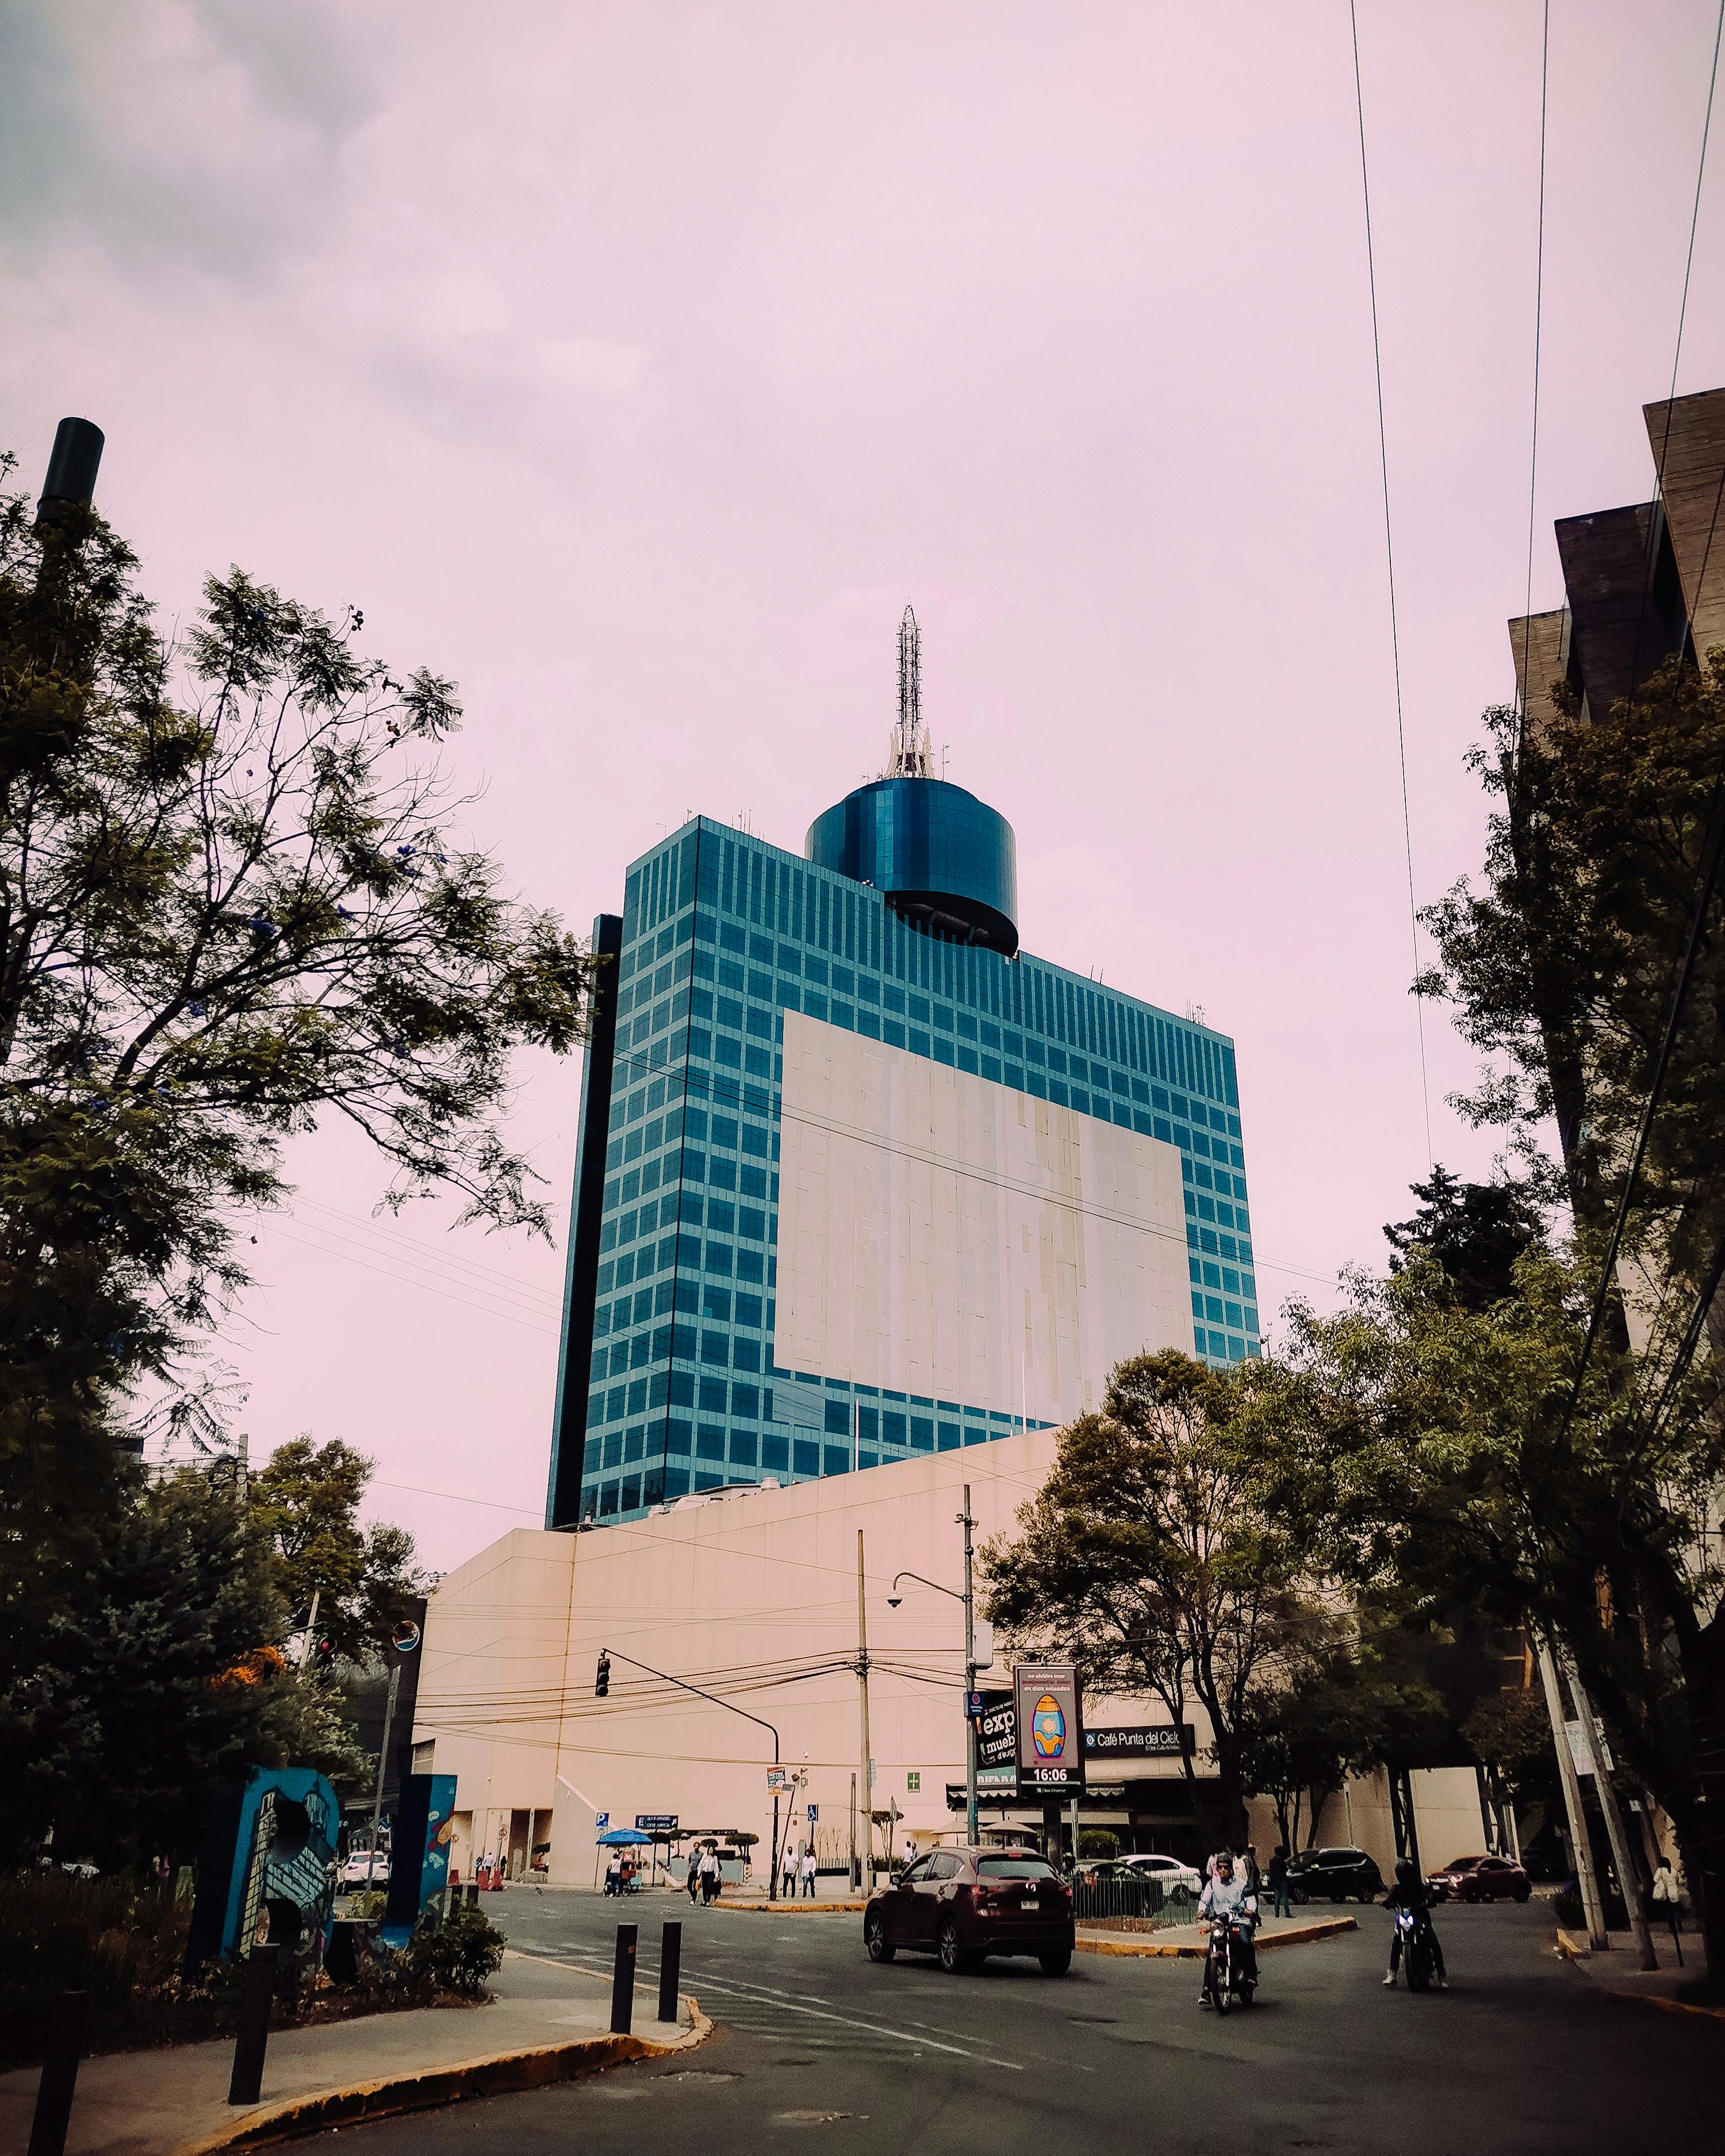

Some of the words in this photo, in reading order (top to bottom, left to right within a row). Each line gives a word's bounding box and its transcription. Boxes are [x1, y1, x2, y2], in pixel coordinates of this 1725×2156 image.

[986, 1732, 1016, 1754] mueb
[1097, 1732, 1118, 1747] Café
[1118, 1732, 1144, 1745] Punta
[1145, 1731, 1159, 1745] del
[1034, 1768, 1067, 1782] 16:06
